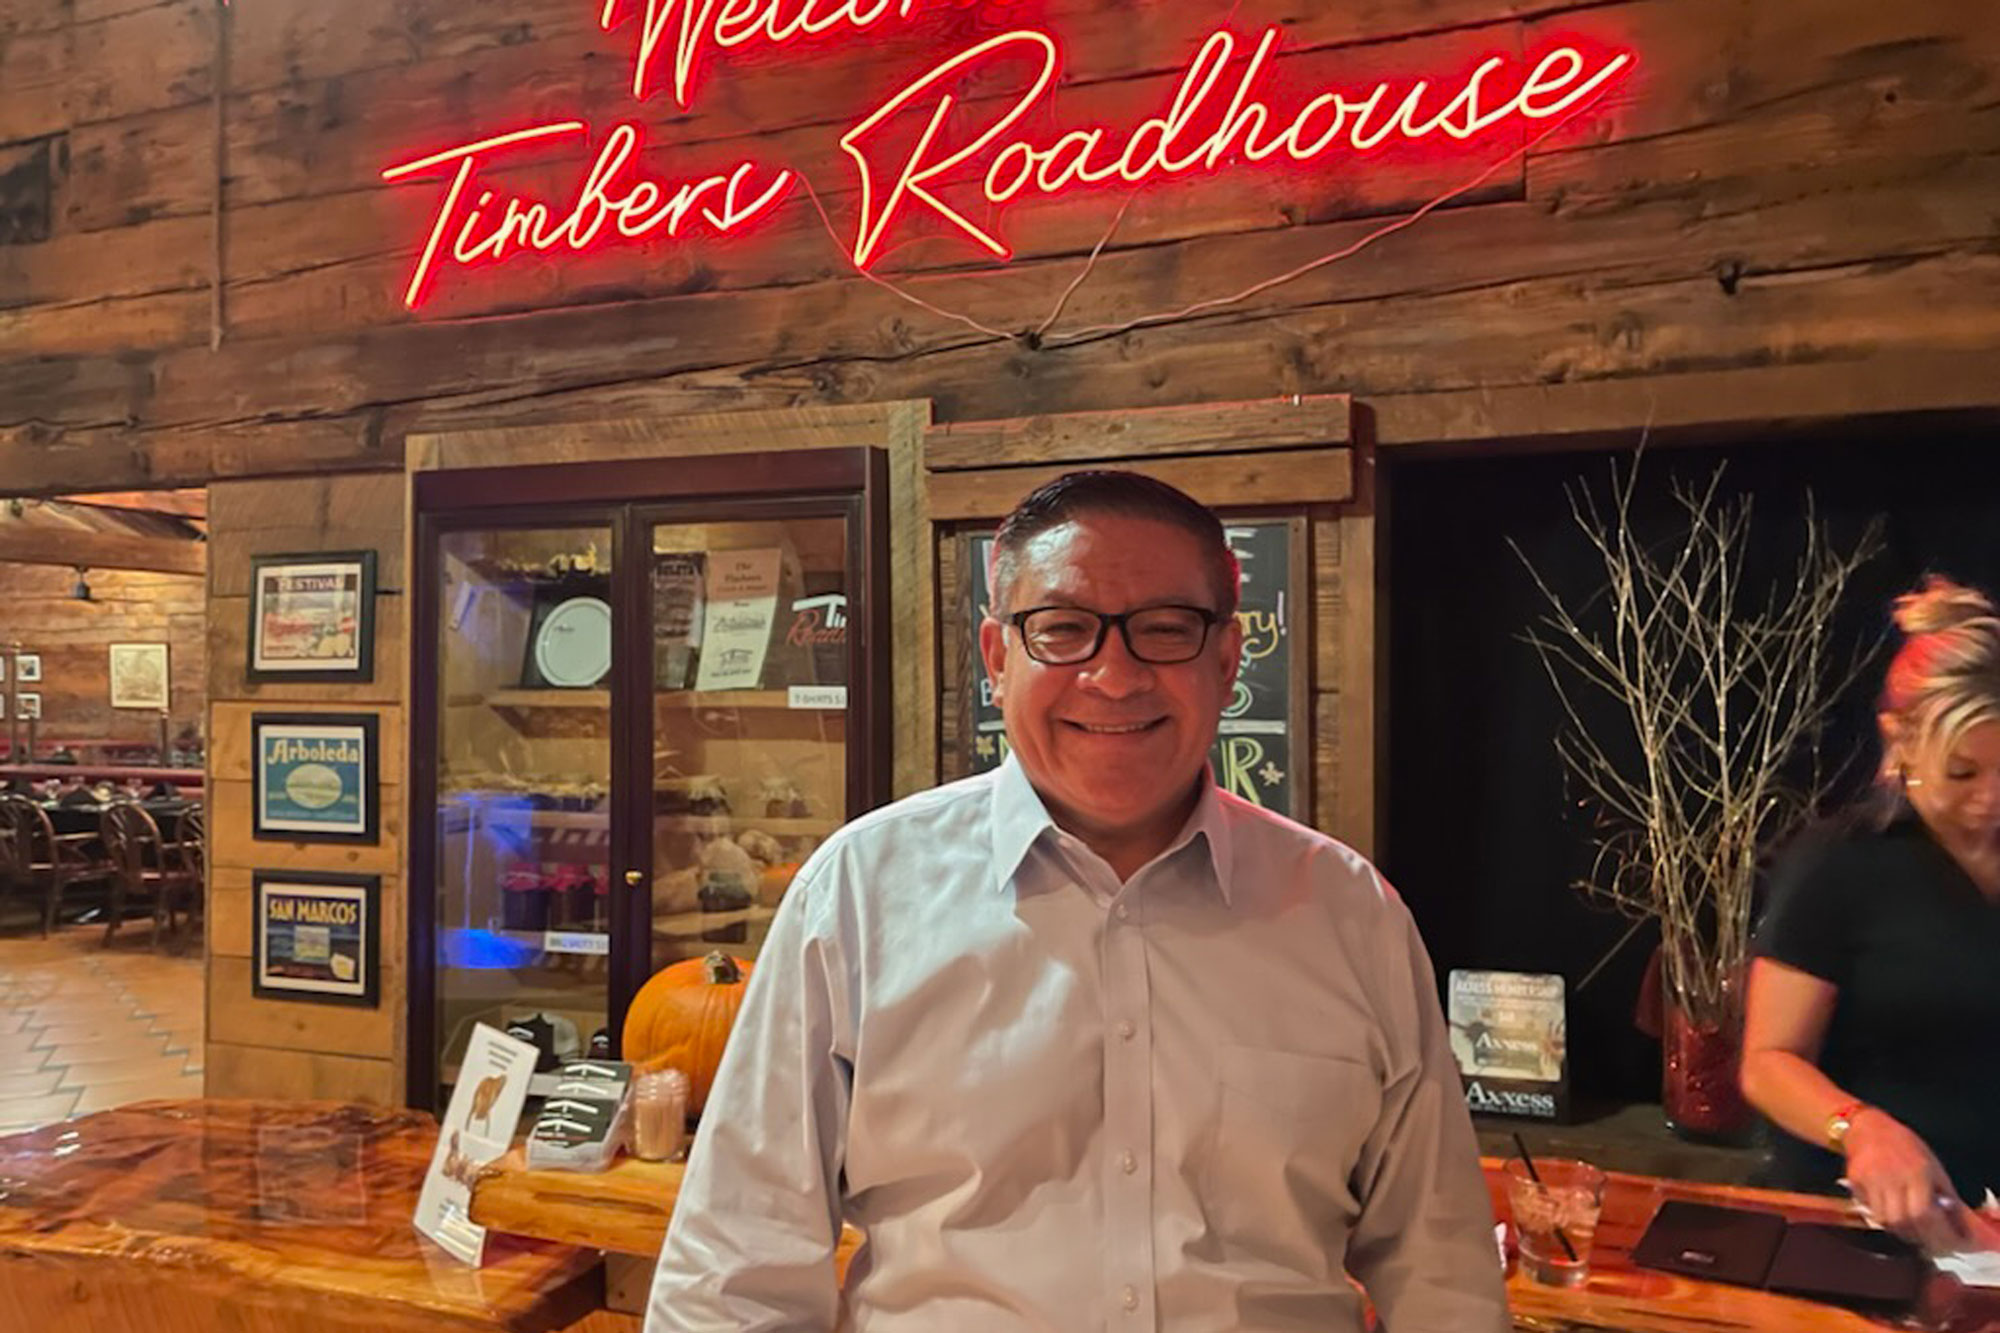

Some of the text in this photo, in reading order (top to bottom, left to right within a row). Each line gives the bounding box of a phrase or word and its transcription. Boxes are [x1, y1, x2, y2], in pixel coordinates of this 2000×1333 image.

[382, 26, 1634, 309] Timbers Roadhouse
[267, 738, 360, 764] Arboleda
[269, 898, 358, 925] SAN MARCOS
[1464, 1081, 1555, 1109] Axxess
